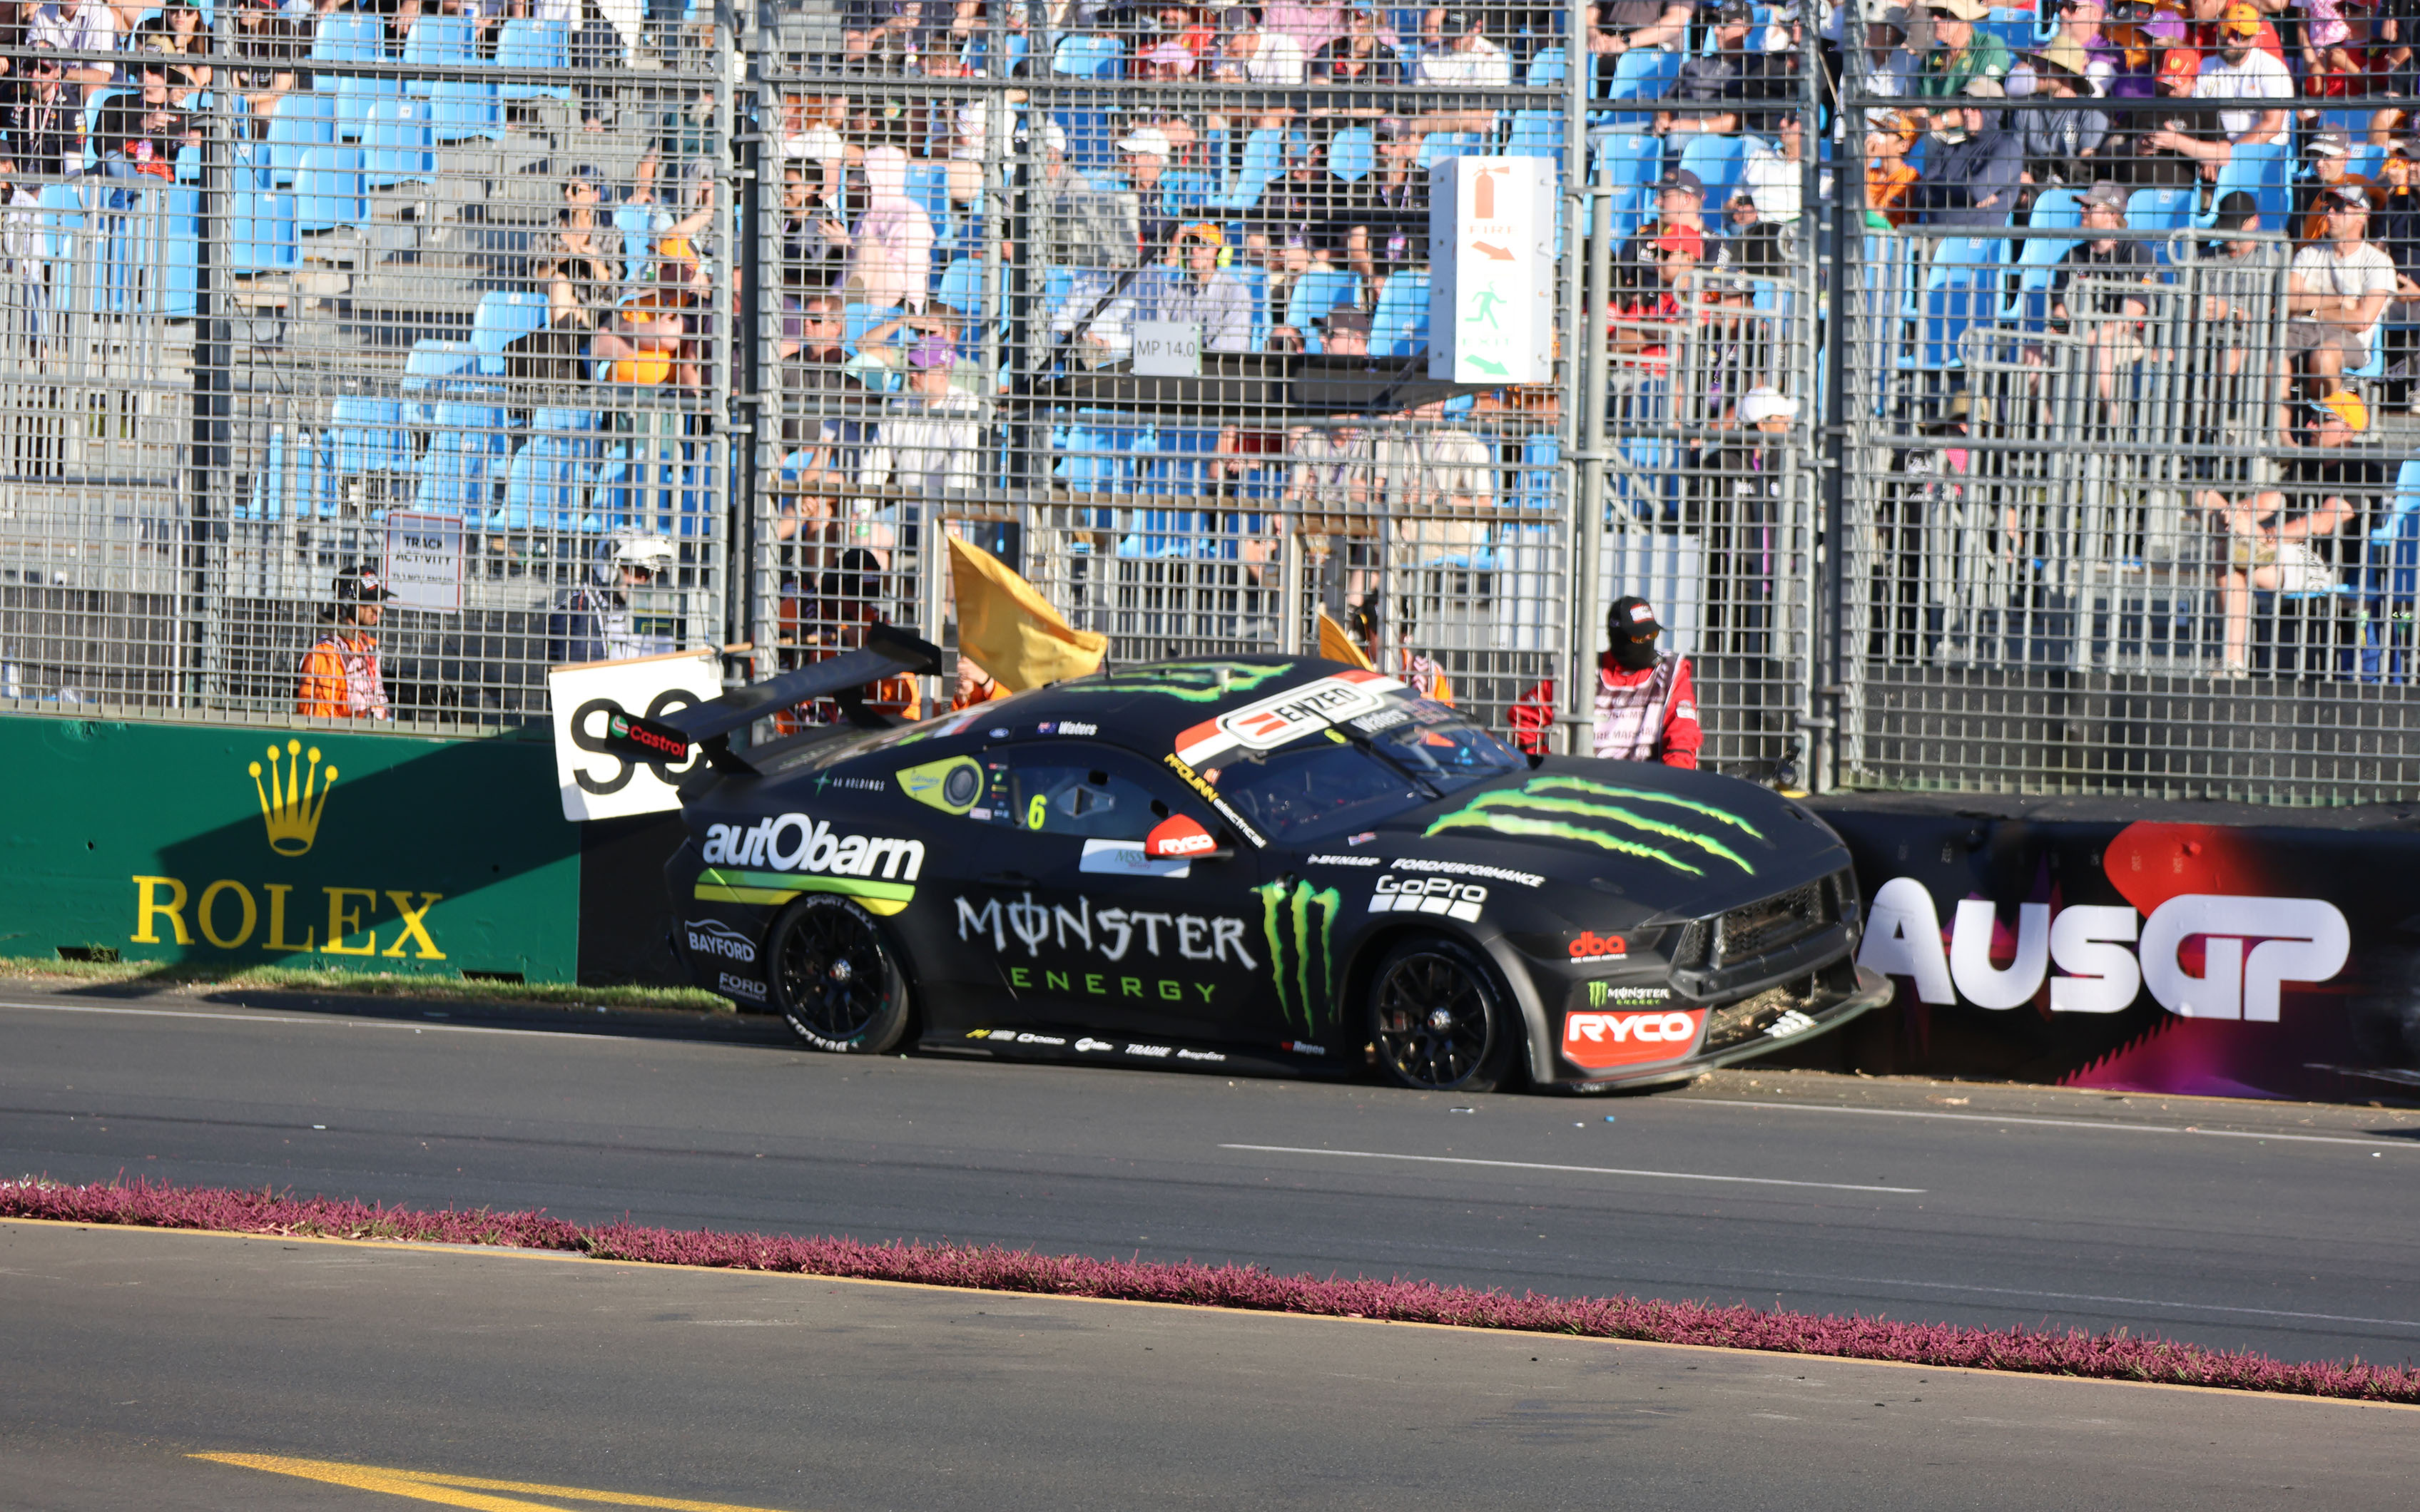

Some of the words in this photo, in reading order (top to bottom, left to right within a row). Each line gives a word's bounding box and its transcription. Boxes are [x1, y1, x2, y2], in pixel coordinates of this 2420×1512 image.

[1469, 225, 1518, 235] FIRE
[1137, 340, 1159, 357] MP
[1165, 341, 1196, 358] 14.0
[1462, 337, 1510, 347] EXIT
[404, 536, 444, 549] TRACK
[395, 550, 451, 566] ACTVITY
[1057, 720, 1099, 736] Waters
[629, 725, 686, 758] Castrol
[1027, 793, 1047, 830] 6
[1158, 834, 1214, 854] RYCO
[1318, 854, 1381, 867] DUNLOP
[1375, 874, 1488, 903] GoPro
[130, 874, 447, 960] ROLEX
[953, 891, 1259, 971] MONSTER
[688, 931, 756, 963] BAYFORD
[1568, 931, 1627, 957] dba
[718, 971, 768, 995] FORD
[1010, 966, 1216, 1003] ENERGY
[1607, 986, 1672, 999] MONSTER
[1567, 1012, 1695, 1043] RYCO
[1124, 1043, 1172, 1058] TRADIE
[1292, 1040, 1326, 1056] Repco
